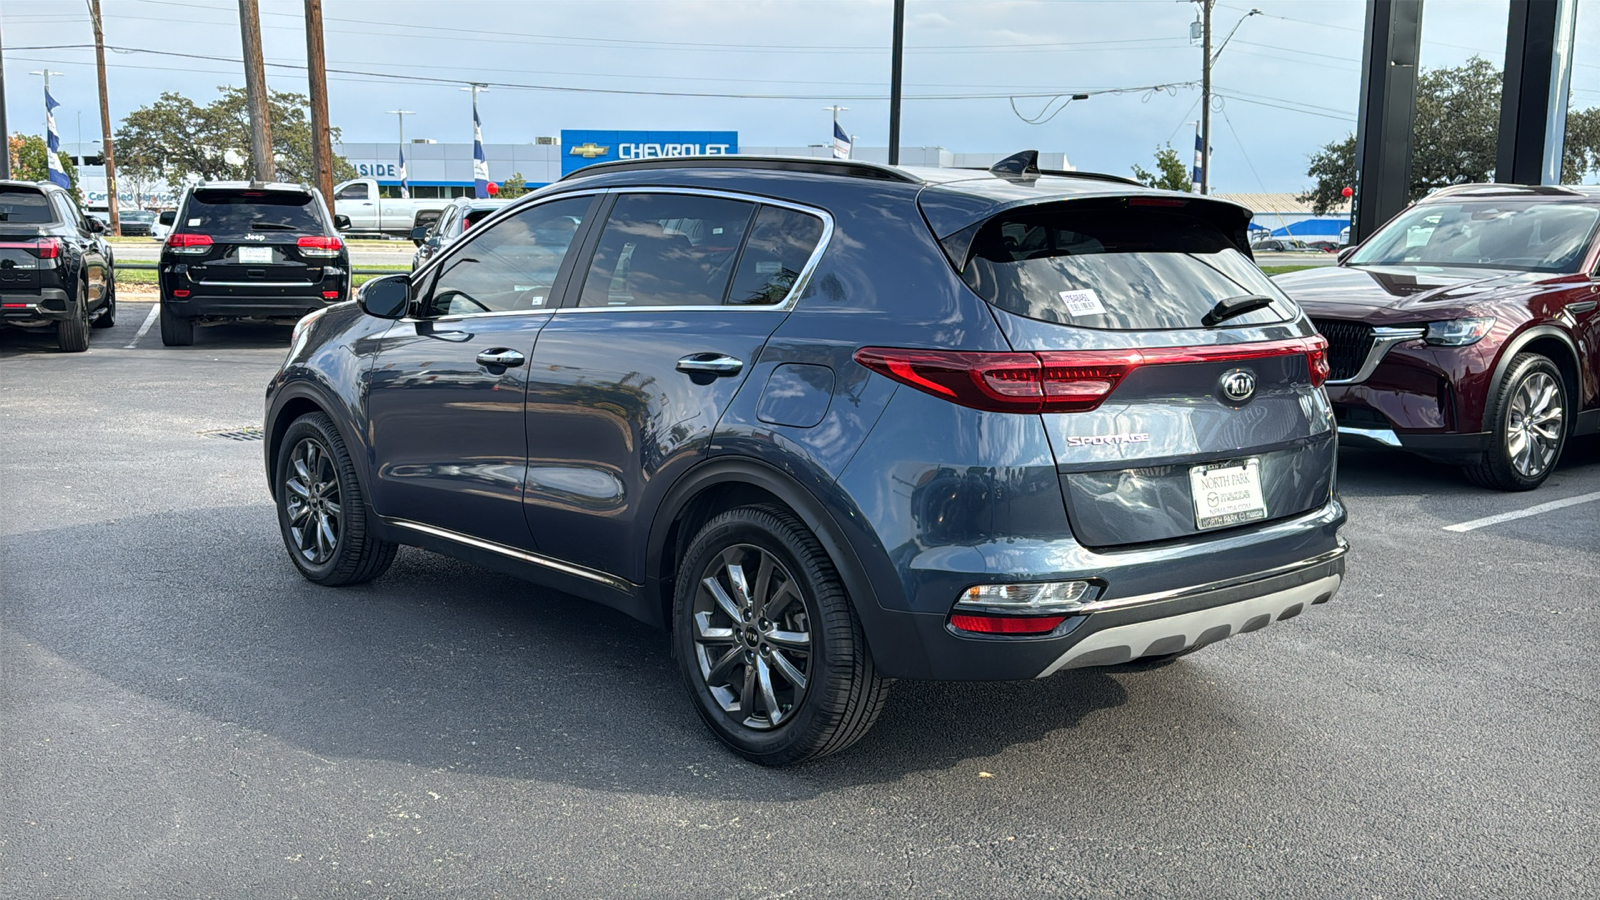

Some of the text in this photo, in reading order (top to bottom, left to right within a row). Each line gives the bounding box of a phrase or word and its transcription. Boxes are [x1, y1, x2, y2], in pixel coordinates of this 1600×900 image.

[618, 143, 730, 159] CHEVROLET
[244, 233, 265, 241] Jeep
[1231, 378, 1252, 394] KIA
[1067, 433, 1149, 447] SPORTAGE
[1201, 472, 1250, 490] NORTH PARK
[1202, 517, 1223, 527] NORTH
[1223, 514, 1239, 525] PARK
